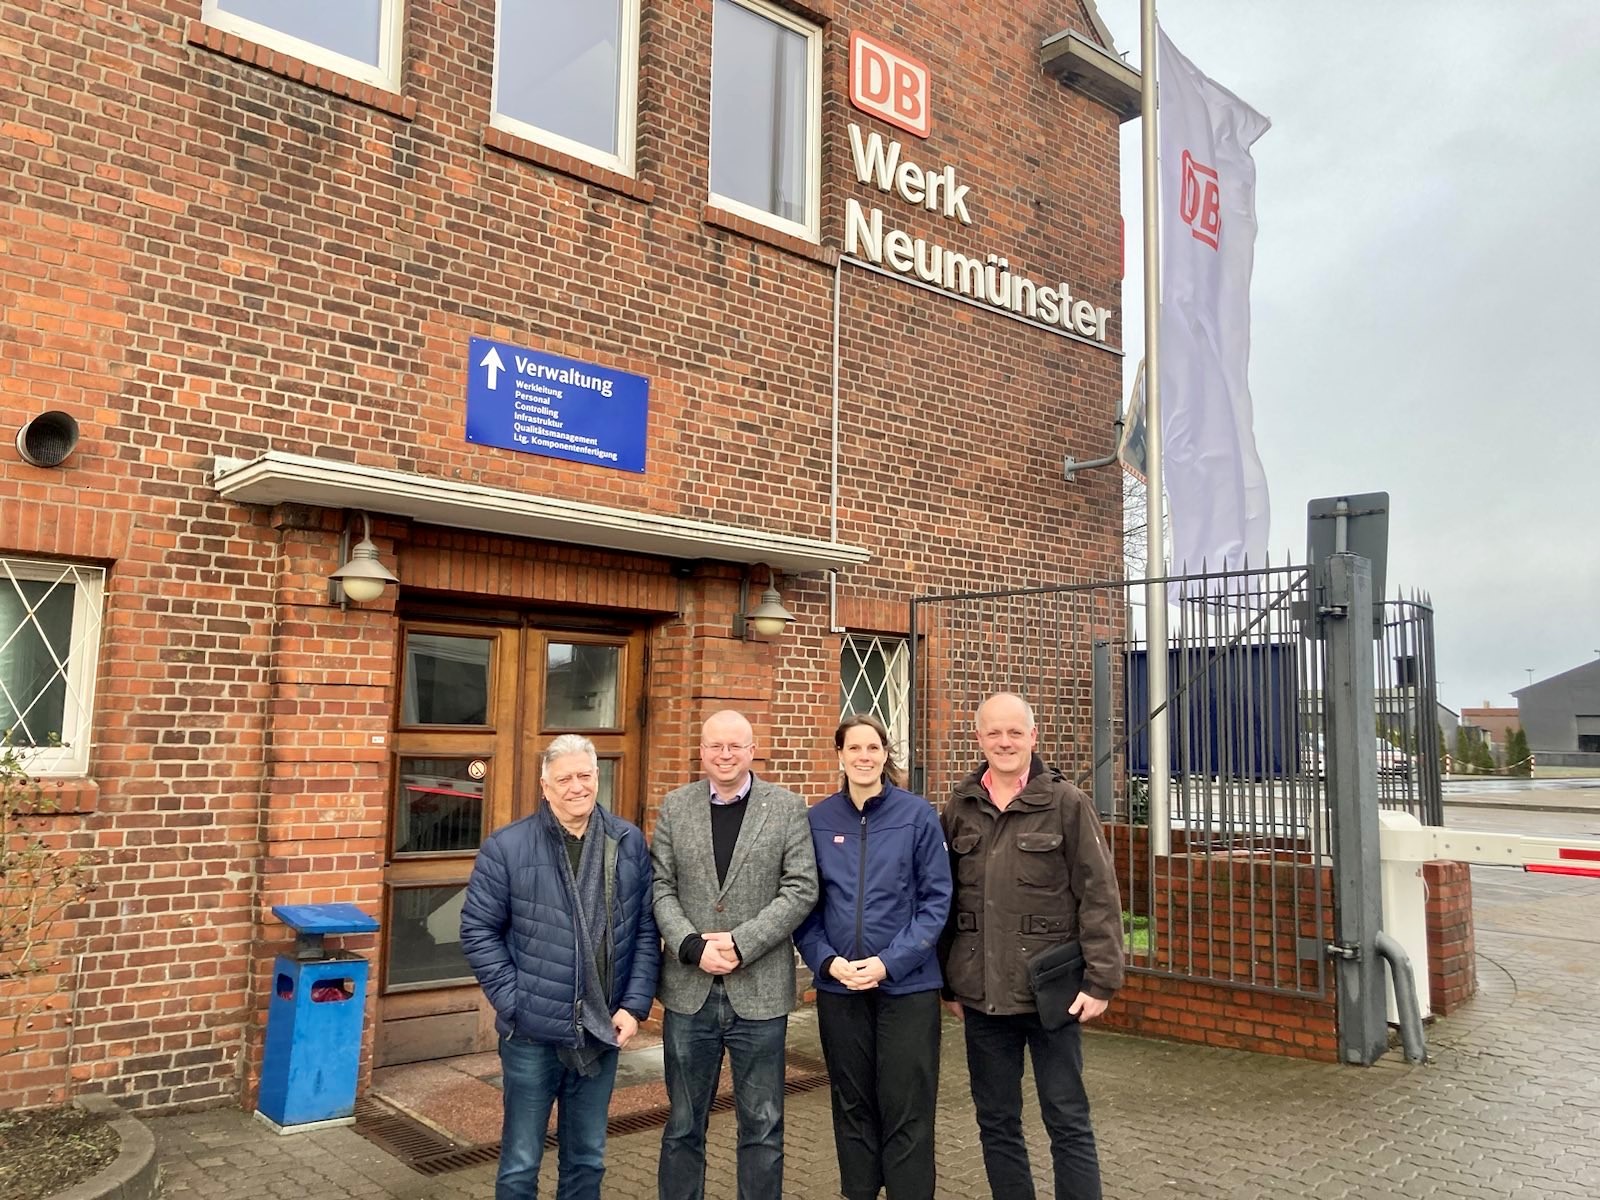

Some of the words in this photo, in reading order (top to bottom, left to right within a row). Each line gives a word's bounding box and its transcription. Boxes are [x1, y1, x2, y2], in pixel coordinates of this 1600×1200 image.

[861, 46, 921, 120] DB
[848, 123, 972, 225] Werk
[1187, 166, 1220, 234] DB
[844, 198, 1111, 341] Neumünster
[514, 355, 613, 397] Verwaltung
[515, 380, 563, 399] Werkleitung
[514, 402, 559, 419] Controlling
[515, 391, 550, 405] Personal
[514, 412, 564, 428] Infrastruktur
[513, 423, 598, 446] Qualitätsmanagement
[513, 433, 529, 445] Ltg.
[531, 436, 618, 461] Komponentenfertigung
